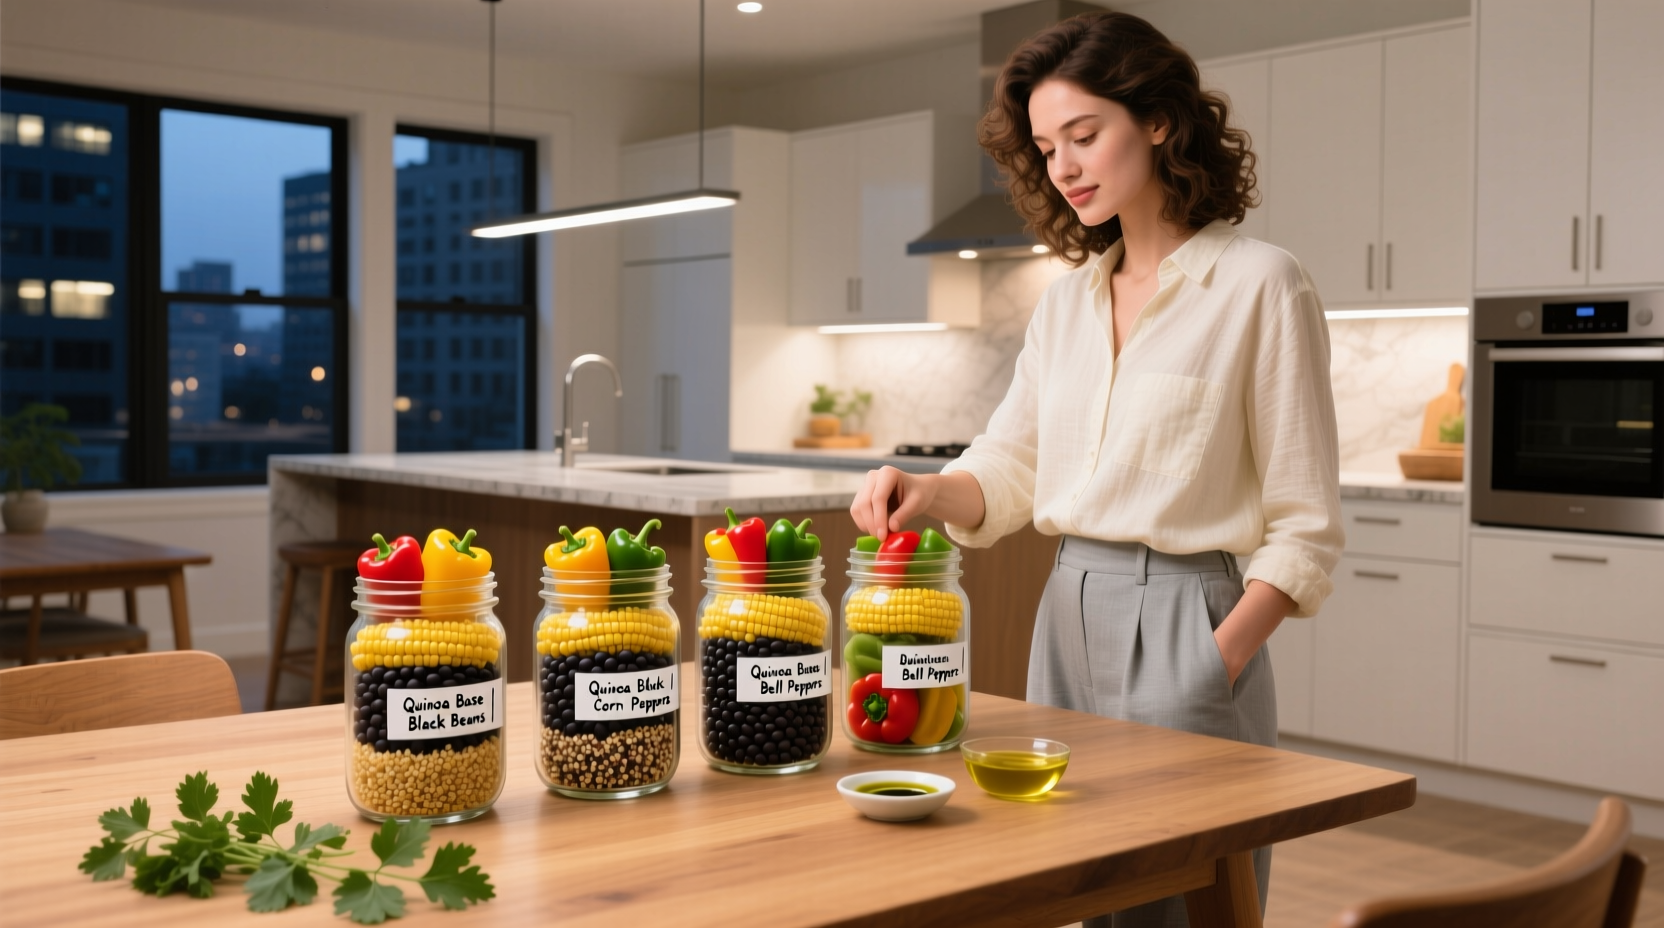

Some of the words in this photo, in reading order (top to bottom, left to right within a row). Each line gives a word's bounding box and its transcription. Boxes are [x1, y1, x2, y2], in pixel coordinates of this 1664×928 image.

[902, 667, 923, 681] Bell
[761, 680, 783, 694] Bell
[403, 697, 450, 713] Quinoa
[456, 693, 484, 708] Base
[594, 699, 624, 711] Corn
[408, 714, 445, 731] Black
[451, 712, 485, 728] Beans
